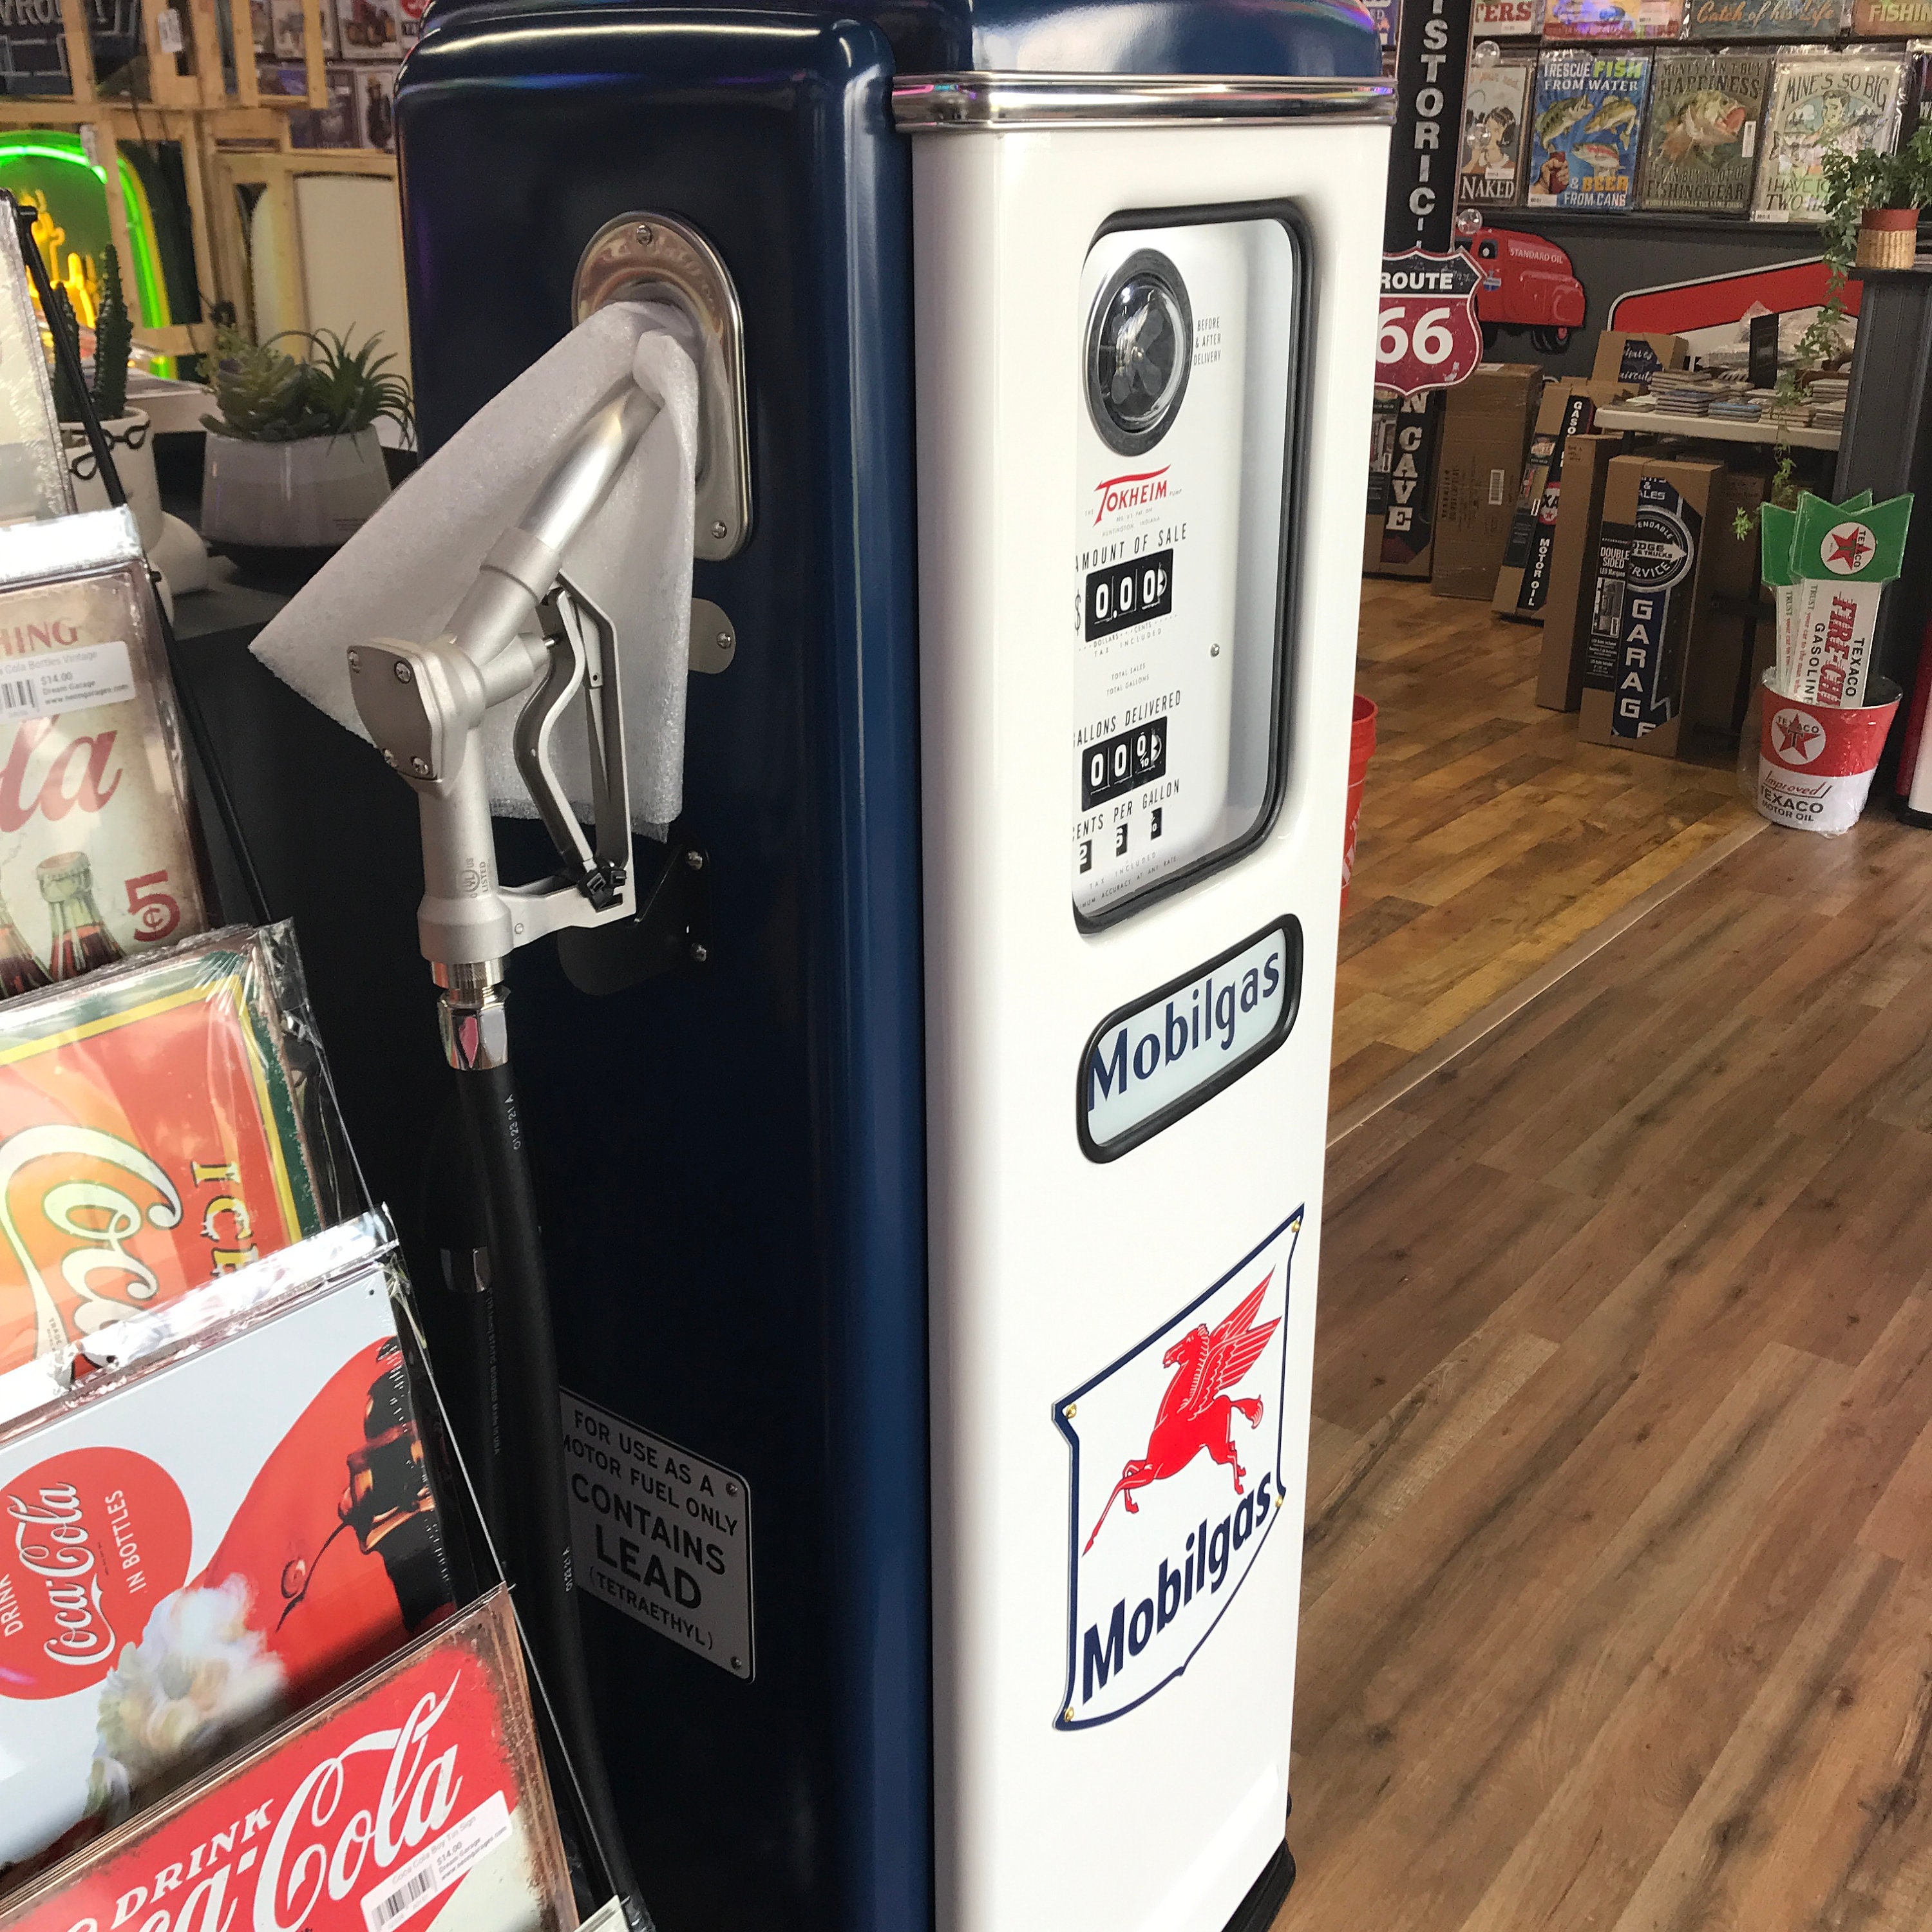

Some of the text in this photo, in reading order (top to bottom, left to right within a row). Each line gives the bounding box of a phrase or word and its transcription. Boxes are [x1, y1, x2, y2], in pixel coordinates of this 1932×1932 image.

[1696, 1, 1743, 23] Catch
[1748, 0, 1770, 28] of
[1550, 62, 1591, 78] RESCUE
[1592, 61, 1642, 79] FISH
[1544, 80, 1638, 91] FROM WATER
[1660, 75, 1761, 99] HAPPINESS
[1782, 72, 1834, 111] MINE'S
[1837, 73, 1861, 91] SO
[1863, 73, 1889, 113] BIG
[1461, 176, 1514, 200] NAKED
[1582, 175, 1629, 193] BEER
[1707, 184, 1745, 200] GEAR
[1773, 177, 1814, 193] HAVE
[1564, 193, 1626, 207] FROM CANS
[1766, 193, 1804, 211] TWO
[1510, 247, 1564, 264] STANDARD OIL
[1380, 271, 1454, 290] ROUTE
[1197, 316, 1220, 332] BEFORE
[1376, 307, 1454, 365] 66
[1195, 333, 1221, 348] & AFTER
[1193, 350, 1221, 366] DELIVERY
[1386, 426, 1423, 531] CAVE
[1093, 464, 1171, 527] TOKHEIM
[1169, 488, 1182, 497] PUMP
[1638, 490, 1666, 500] ALES
[1102, 516, 1160, 537] HUNTINGTON INDIANA
[1134, 534, 1148, 554] OF
[1158, 523, 1186, 547] SALE
[1636, 521, 1674, 540] ENDABLE
[1600, 546, 1631, 561] DOUBLE
[1602, 556, 1625, 569] SIDED
[1853, 530, 1866, 569] TEXACO
[1528, 538, 1551, 607] MOTOR OIL
[1808, 585, 1819, 610] TRUST
[1075, 589, 1081, 636] $
[1094, 621, 1152, 648] DOLLARS CENTS
[1094, 628, 1162, 658] TAX INCLUDED
[1817, 593, 1857, 706] FIRE-CHI
[41, 671, 73, 686] $14.00
[1112, 662, 1146, 681] TOTAL SALES
[1845, 638, 1866, 697] TEXACO
[1106, 674, 1150, 696] TOTAL GALLONS
[1074, 690, 1181, 748] ALLONS DELIVERED
[1776, 715, 1820, 734] TEXACO
[1765, 771, 1826, 795] Improved
[1072, 814, 1104, 842] ENTS
[1113, 800, 1133, 823] PER
[1142, 779, 1180, 810] GALLON
[1759, 785, 1824, 814] TEXACO
[1762, 800, 1814, 822] MOTOR OIL
[466, 857, 475, 868] US
[1089, 851, 1157, 889] TAX INCLUDED
[478, 861, 488, 893] LISTED
[1101, 880, 1132, 898] ACCURACY
[1163, 855, 1177, 866] RATE
[1087, 952, 1280, 1113] Mobilgas
[48, 1317, 62, 1346] TRADE
[574, 1408, 714, 1497] FOR USE AS A
[630, 1468, 680, 1508] FUEL
[686, 1497, 738, 1537] ONLY
[571, 1472, 726, 1575] CONTAINS
[104, 1490, 147, 1594] IN BOTTLES
[596, 1523, 702, 1609] LEAD
[1082, 1471, 1271, 1706] Mobilgas
[589, 1566, 714, 1651] (TETRAETHYL)
[431, 1841, 446, 1856] Boy
[460, 1816, 477, 1832] Sign
[110, 1798, 276, 1931] DRINK
[437, 1841, 463, 1866] $14.00
